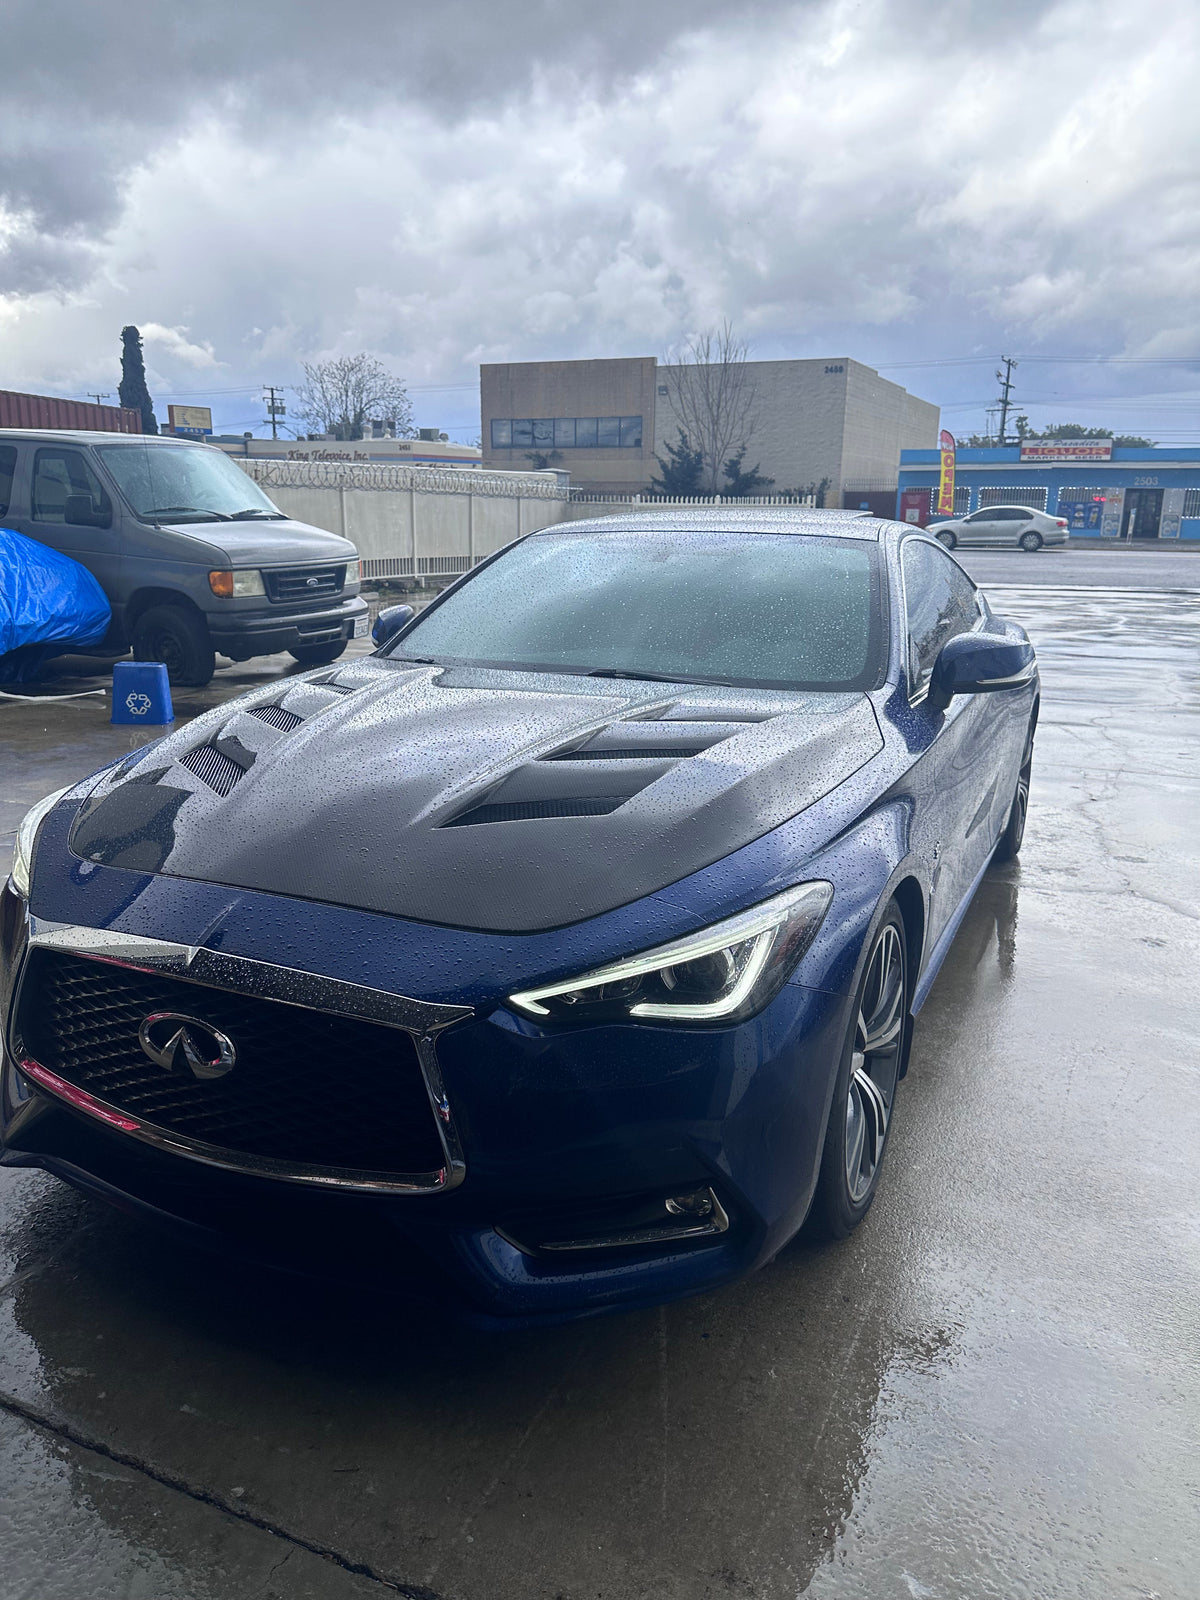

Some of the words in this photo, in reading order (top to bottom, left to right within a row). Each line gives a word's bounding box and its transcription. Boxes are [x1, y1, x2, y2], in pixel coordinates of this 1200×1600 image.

[1032, 439, 1049, 447] La
[1053, 439, 1100, 447] Pasadita
[287, 449, 309, 461] King
[1025, 447, 1106, 456] LIQUOR
[1134, 476, 1159, 486] 2503
